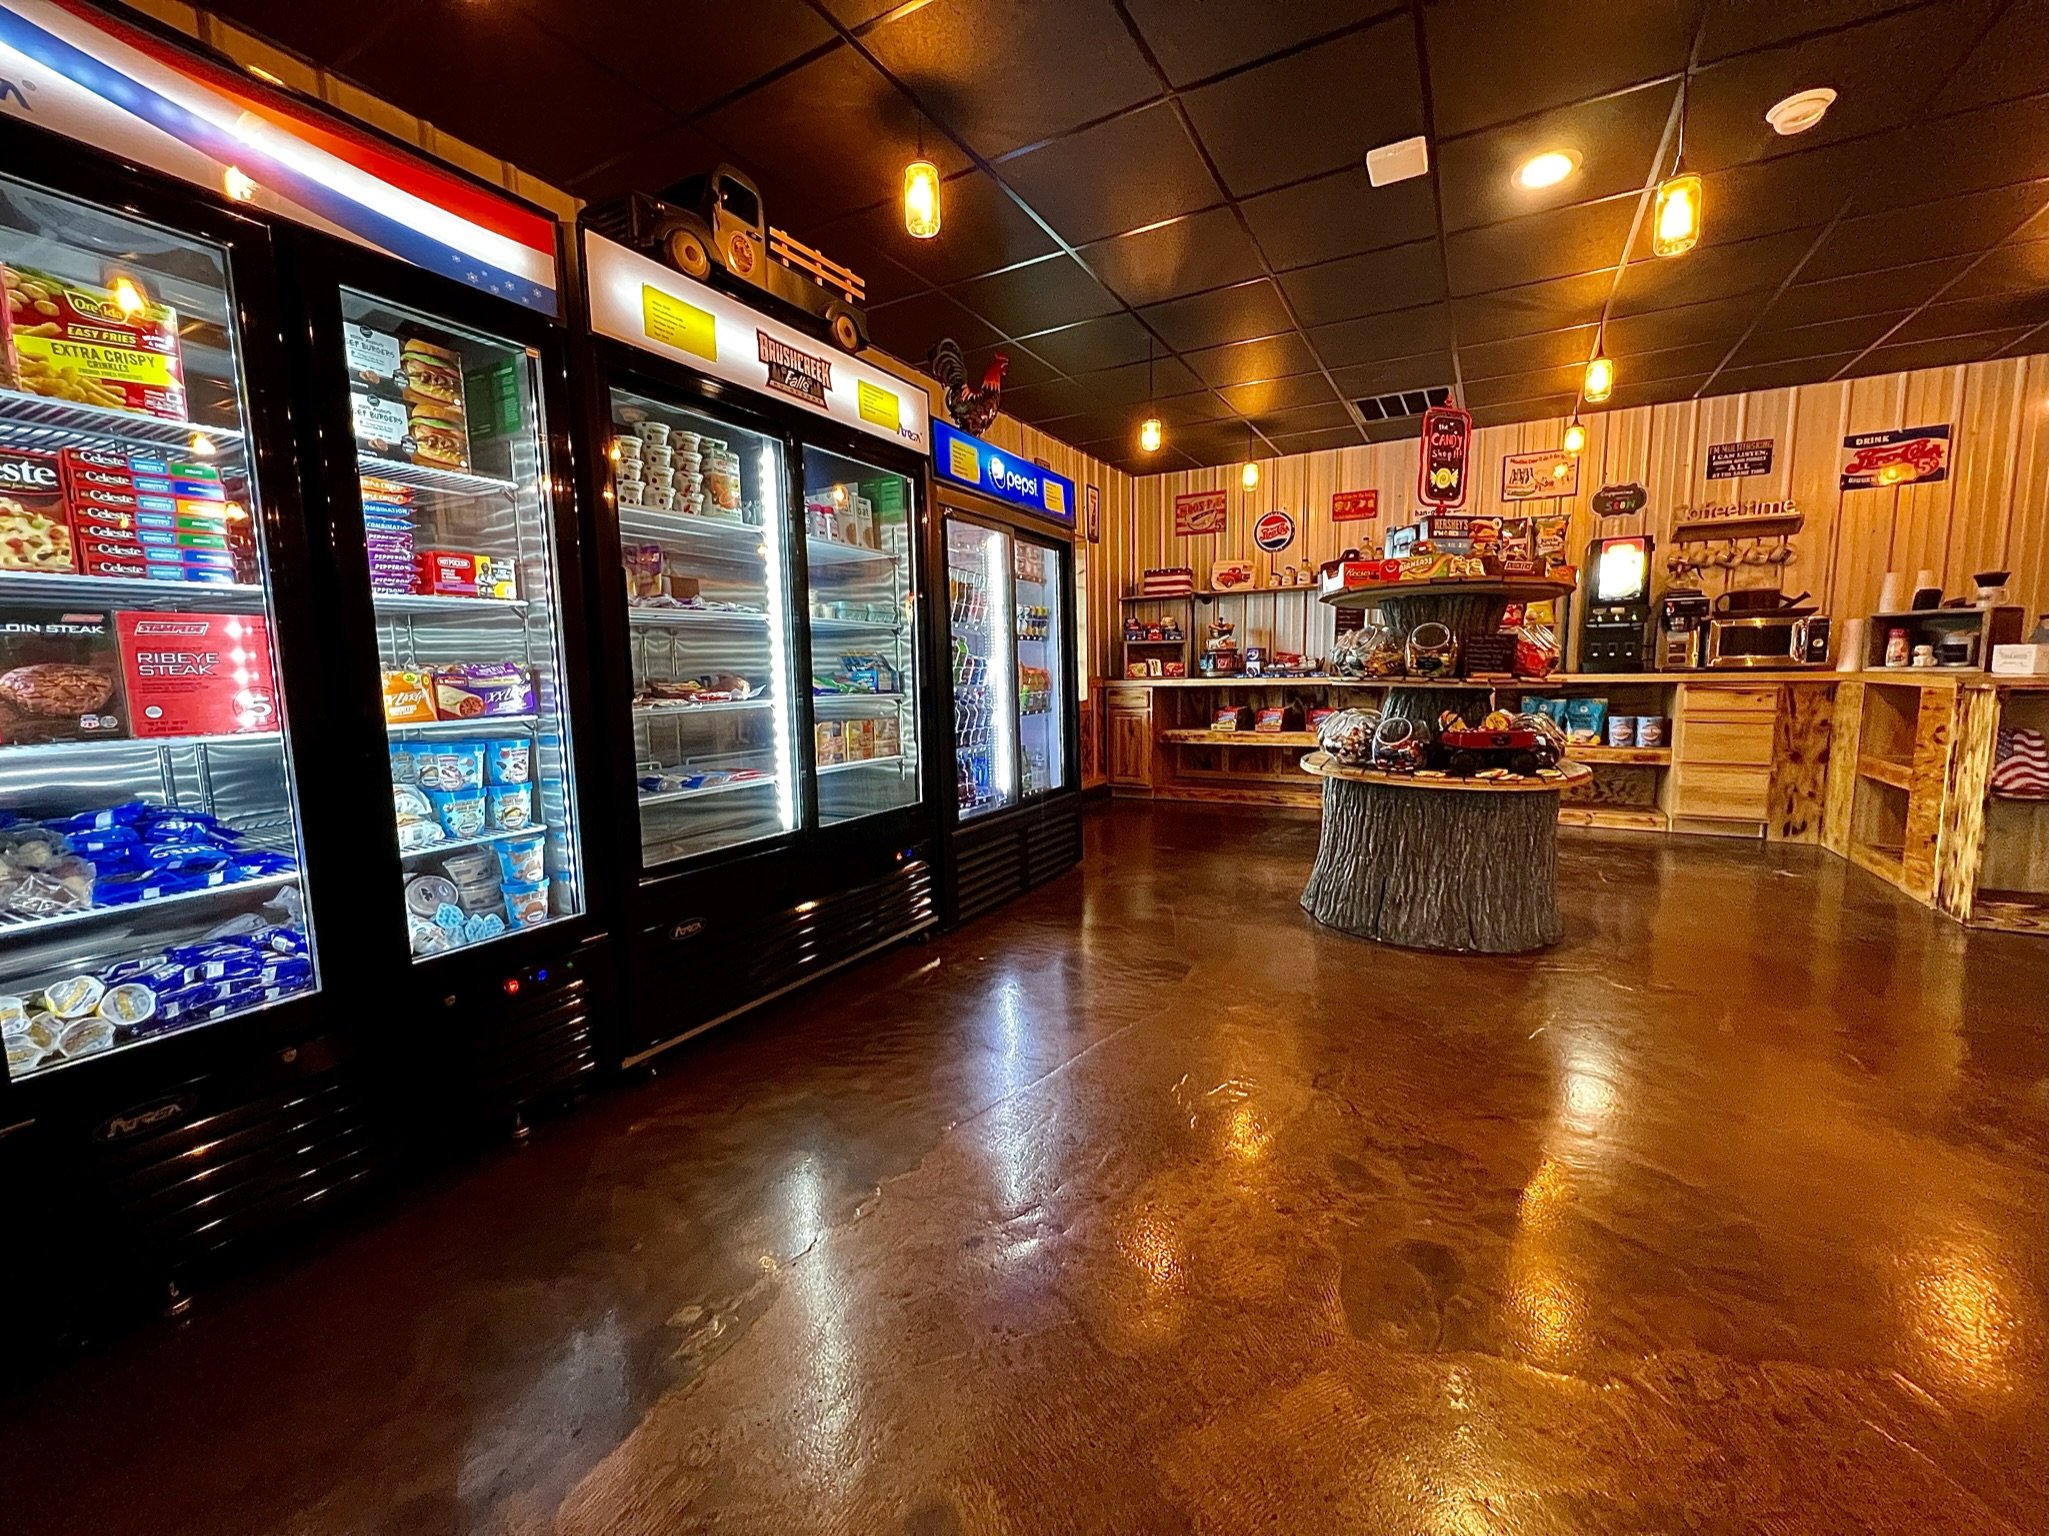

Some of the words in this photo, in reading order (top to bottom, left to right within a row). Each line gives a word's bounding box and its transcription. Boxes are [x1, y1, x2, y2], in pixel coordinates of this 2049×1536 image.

[67, 325, 99, 340] EASY
[102, 332, 137, 345] FRIES
[51, 341, 101, 362] EXTRA
[103, 349, 156, 369] CRISPY
[758, 334, 831, 391] BRUSHCREEK
[784, 369, 810, 393] Falls
[1431, 431, 1463, 449] CANDY
[1855, 435, 1890, 446] DRINK
[79, 452, 127, 468] Celeste
[1728, 462, 1751, 472] ALL
[0, 461, 57, 487] este
[84, 470, 131, 486] Celeste
[1006, 470, 1038, 497] pepsi
[89, 489, 135, 504] Celeste
[87, 507, 132, 524] Celeste
[1433, 518, 1469, 530] HERSHEY'S
[89, 525, 135, 541] Celeste
[97, 543, 142, 558] Celeste
[100, 562, 144, 577] Celeste
[46, 624, 105, 634] STEAK
[136, 652, 220, 664] RIBEYE
[138, 664, 214, 677] STEAK
